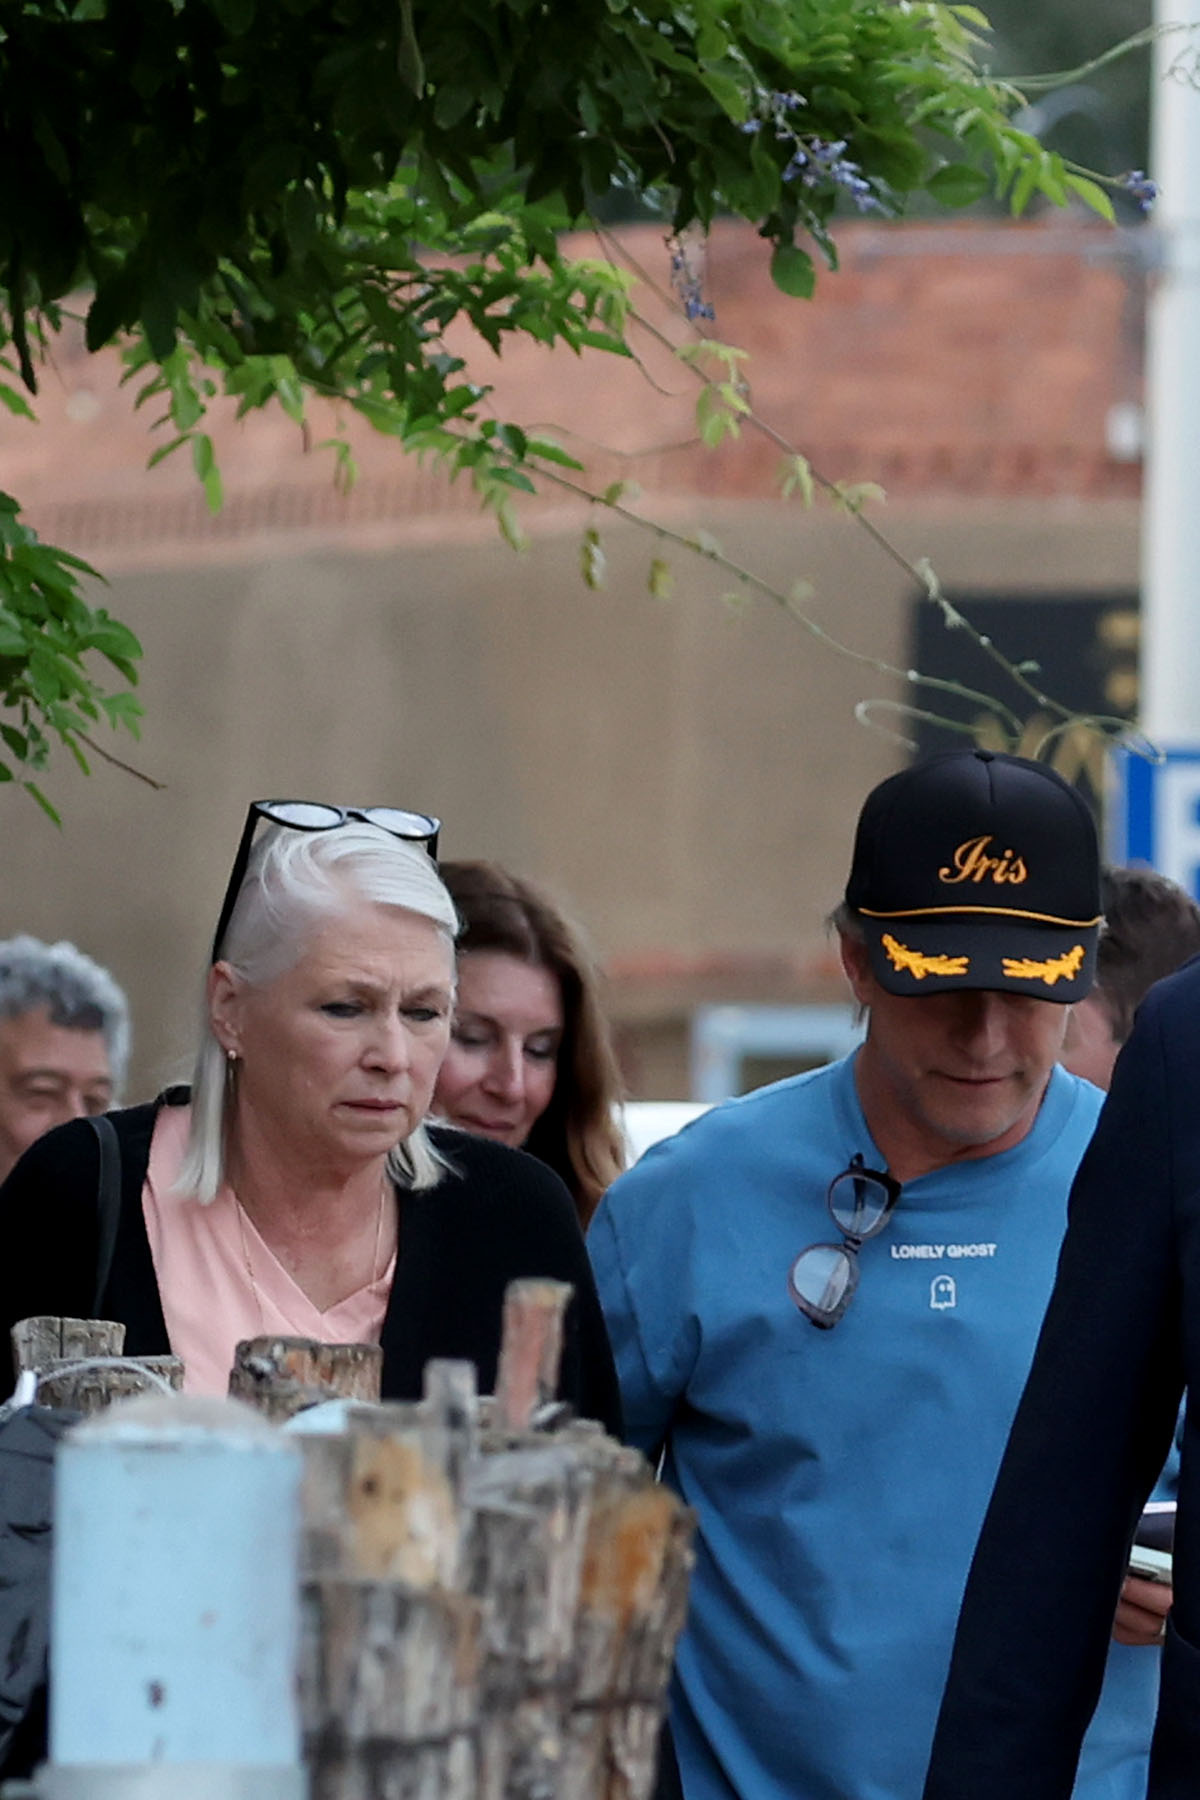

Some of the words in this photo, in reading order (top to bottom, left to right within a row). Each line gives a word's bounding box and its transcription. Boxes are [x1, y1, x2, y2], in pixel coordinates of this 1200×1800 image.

[939, 836, 1027, 885] Iris
[891, 1245, 945, 1259] LONELY
[947, 1244, 997, 1257] GHOST
